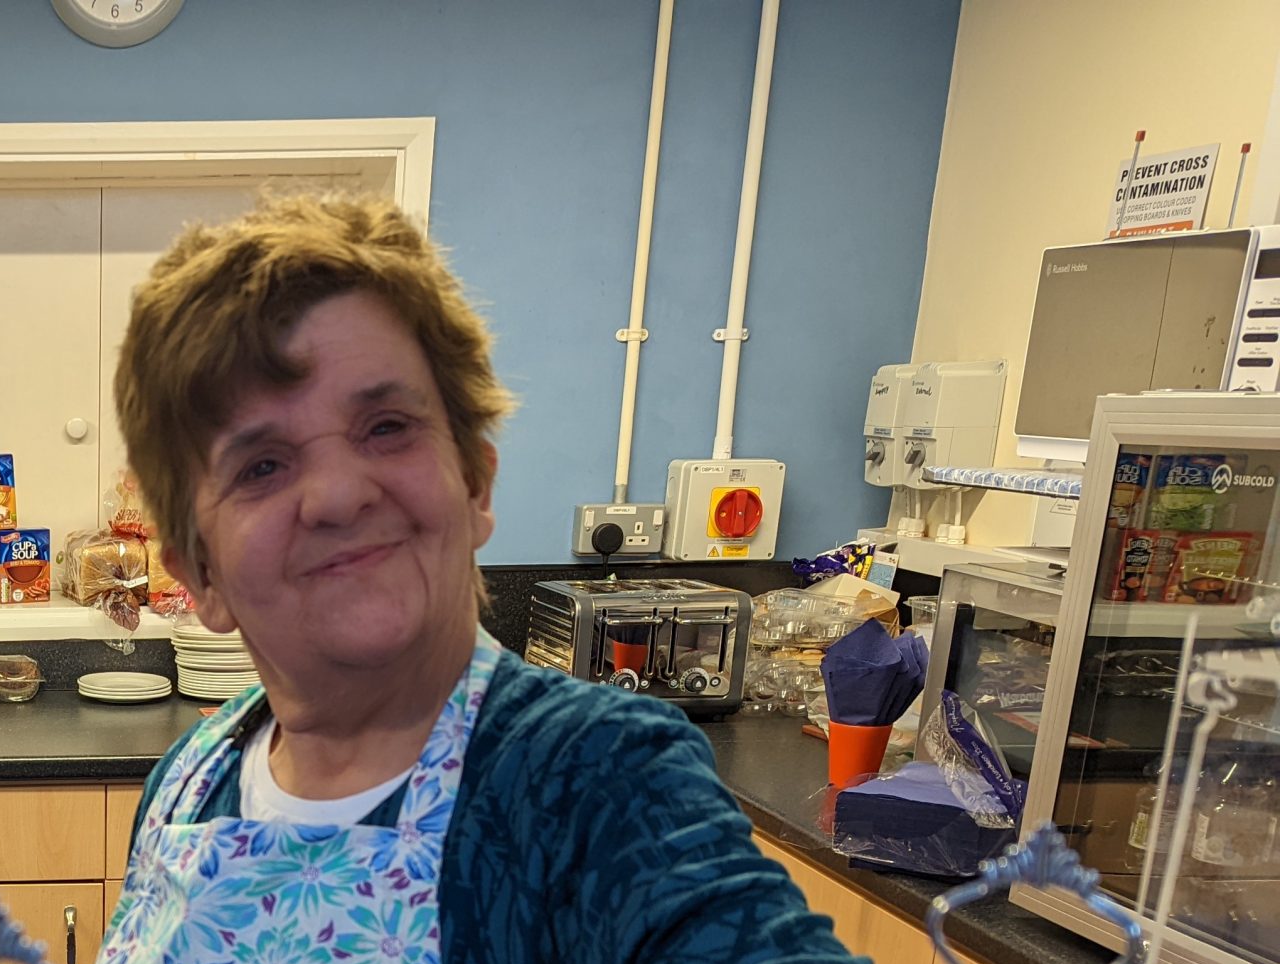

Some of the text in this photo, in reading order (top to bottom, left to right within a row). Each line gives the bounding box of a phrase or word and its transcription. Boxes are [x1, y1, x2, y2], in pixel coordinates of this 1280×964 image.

[111, 4, 119, 18] 6
[135, 0, 143, 12] 5
[1121, 155, 1209, 182] PEVENT CROSS
[1127, 202, 1152, 214] CORRECT
[1153, 199, 1175, 210] COLOUR
[1176, 196, 1197, 206] CODED
[1116, 213, 1143, 225] COPPING
[1144, 210, 1166, 221] BOARDS
[1171, 206, 1192, 216] KNIVES
[1233, 475, 1275, 487] SUBCOLD
[12, 551, 38, 560] SOUP
